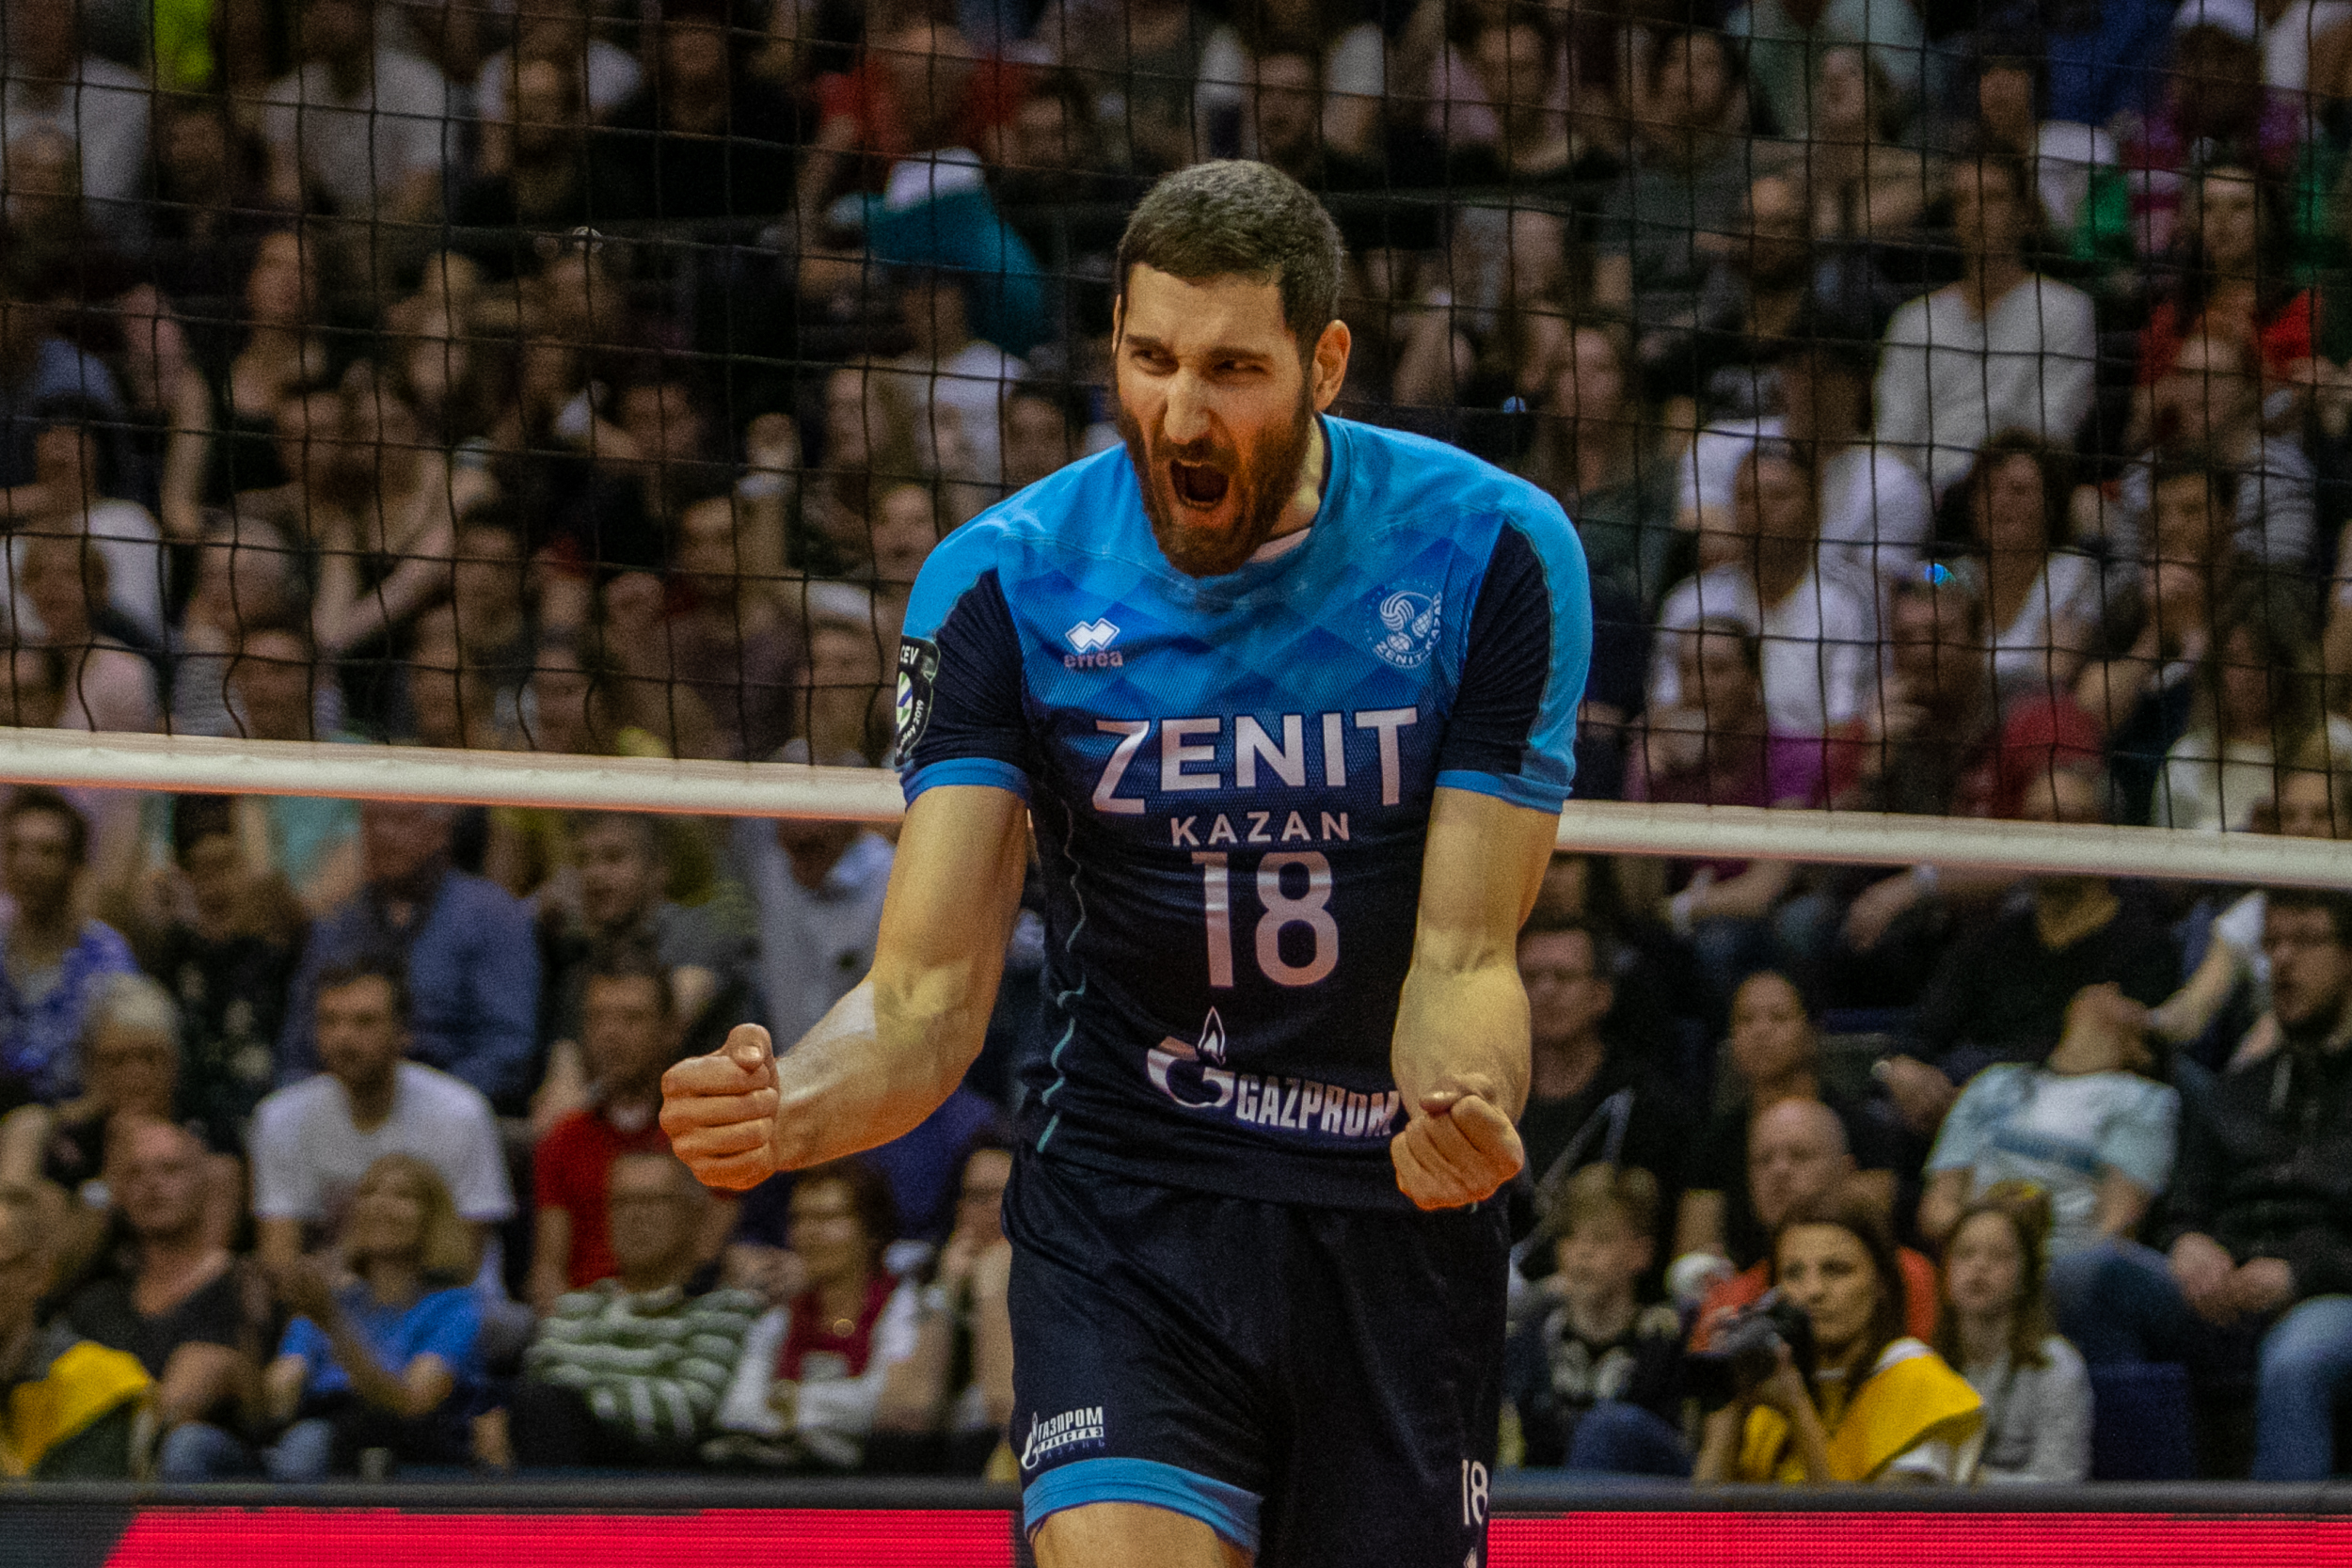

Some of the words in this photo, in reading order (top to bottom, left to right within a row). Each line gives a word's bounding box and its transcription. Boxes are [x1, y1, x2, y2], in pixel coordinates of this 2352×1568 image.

[913, 699, 925, 726] 2019
[1091, 707, 1418, 815] ZENIT
[1170, 811, 1350, 847] KAZAN
[1191, 850, 1340, 988] 18
[1234, 1073, 1400, 1137] GAZPROM
[1038, 1405, 1104, 1442] ГАЗПРОМ
[1461, 1458, 1488, 1527] 18
